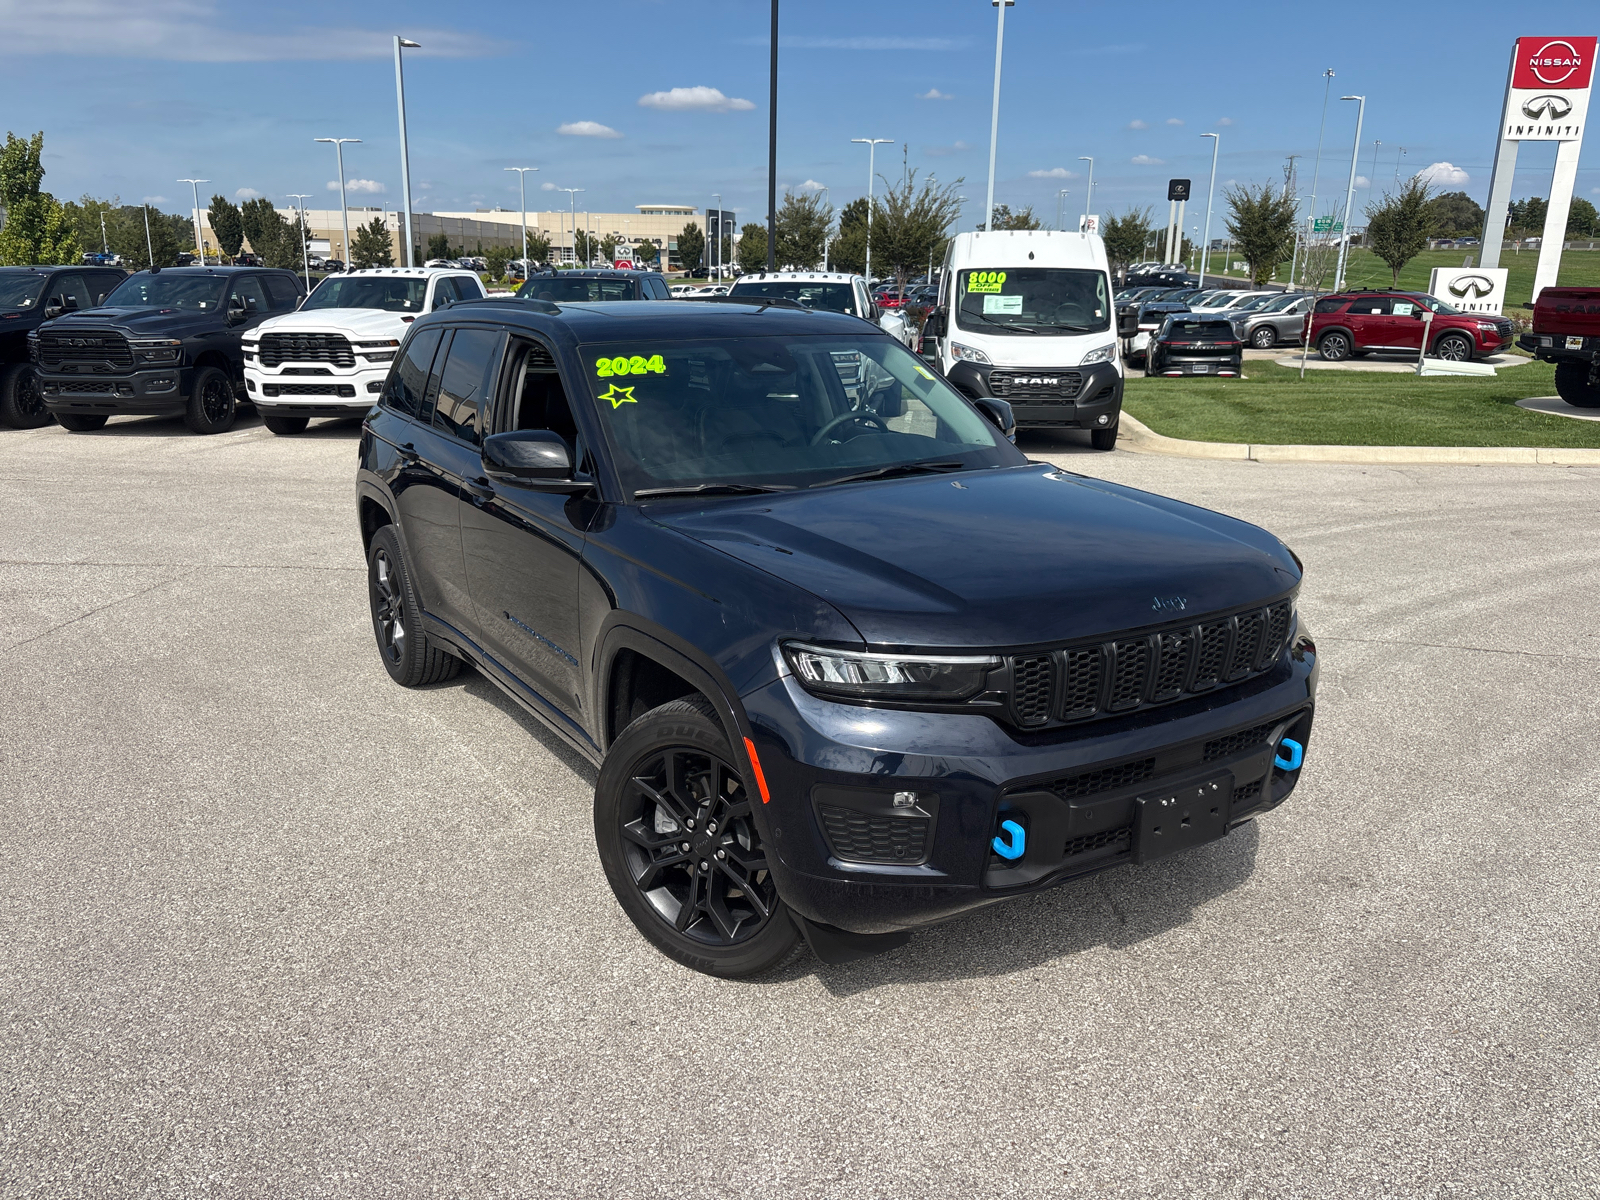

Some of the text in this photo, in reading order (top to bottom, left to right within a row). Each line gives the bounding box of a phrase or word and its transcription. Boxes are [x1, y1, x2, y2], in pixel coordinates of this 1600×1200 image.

[1529, 58, 1581, 66] NISSAN
[1508, 125, 1579, 135] INFINITI
[968, 271, 1007, 284] 8000
[1449, 303, 1498, 311] FINITI
[57, 338, 103, 346] RAM
[279, 339, 326, 348] RAM
[596, 354, 667, 378] 2024
[1151, 596, 1187, 611] Jeep
